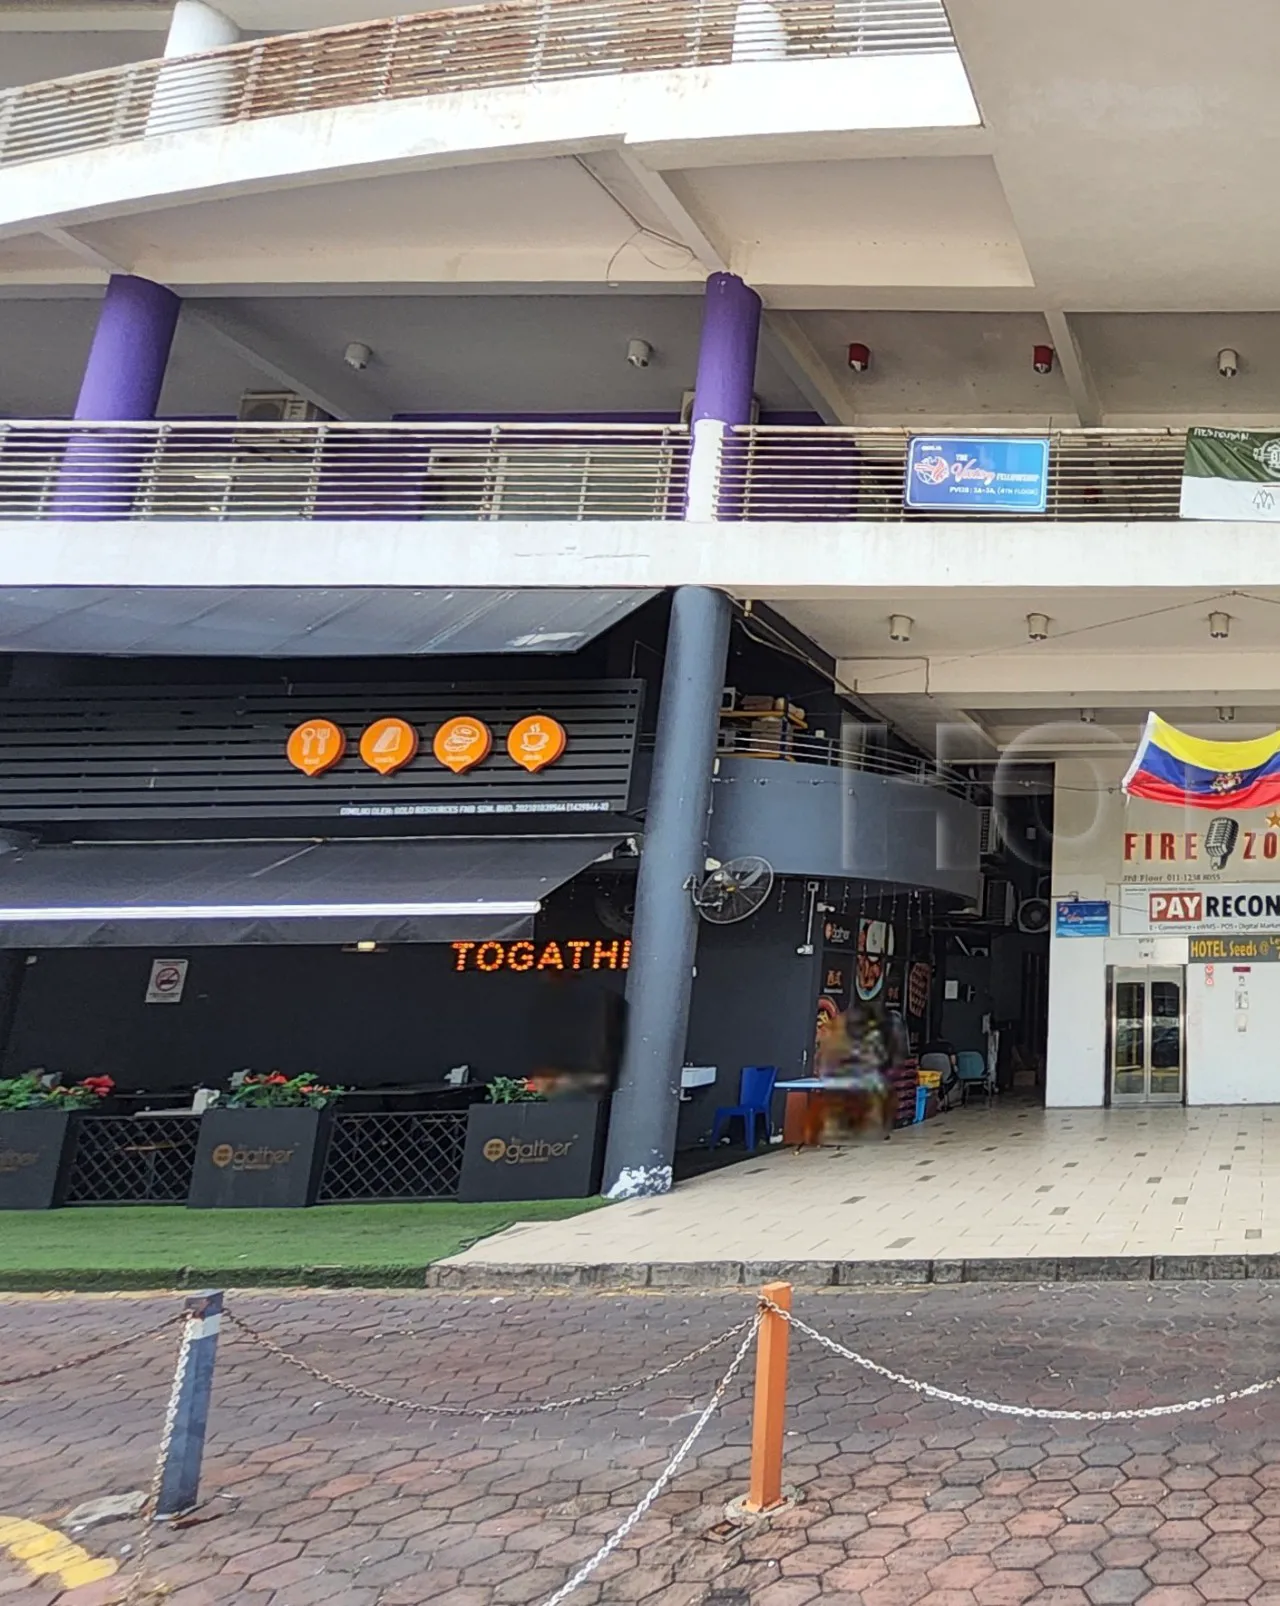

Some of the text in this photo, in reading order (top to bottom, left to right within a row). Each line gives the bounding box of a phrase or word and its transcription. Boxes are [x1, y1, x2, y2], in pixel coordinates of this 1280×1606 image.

[1123, 831, 1199, 861] FIRE
[1138, 873, 1164, 882] Floor
[1151, 895, 1201, 919] PAY
[1190, 939, 1227, 958] HOTEL
[1229, 939, 1258, 958] Seeds
